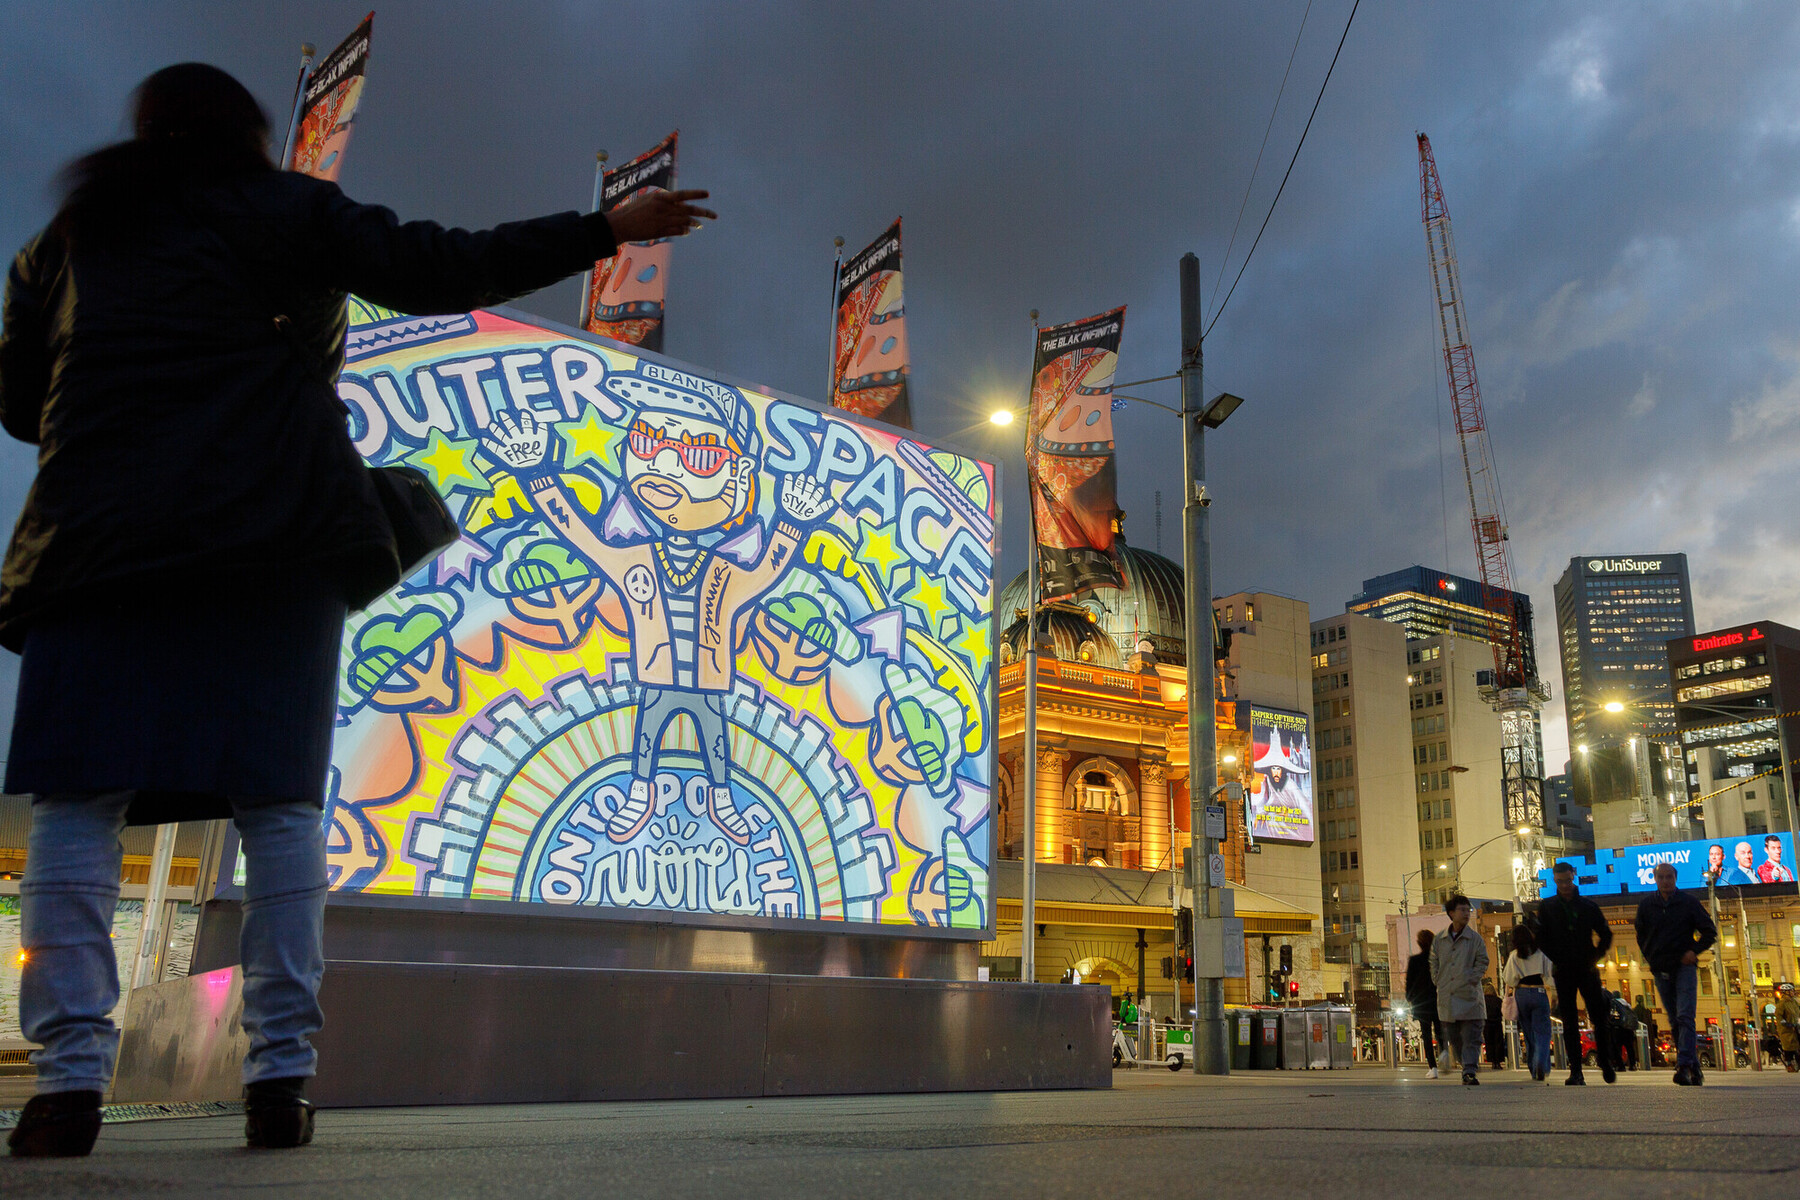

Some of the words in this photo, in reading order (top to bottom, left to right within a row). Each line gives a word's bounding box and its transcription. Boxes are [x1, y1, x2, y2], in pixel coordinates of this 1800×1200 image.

[605, 183, 618, 199] THE
[618, 171, 639, 192] BLAK
[850, 259, 868, 284] BLAK
[1042, 339, 1058, 351] THE
[1057, 333, 1081, 348] BLAK
[1081, 322, 1119, 341] INFINITE
[648, 366, 721, 401] BLANK!
[337, 346, 624, 459] OUTER
[766, 401, 993, 614] SPACE
[1604, 558, 1662, 574] UniSuper
[1693, 632, 1744, 652] Emirates
[1251, 709, 1274, 720] EMPIRE
[1273, 713, 1283, 721] OF
[1283, 714, 1295, 723] THE
[1295, 716, 1307, 725] SUN
[632, 786, 645, 794] AIR
[716, 792, 729, 800] AIR
[1637, 849, 1691, 867] MONDAY
